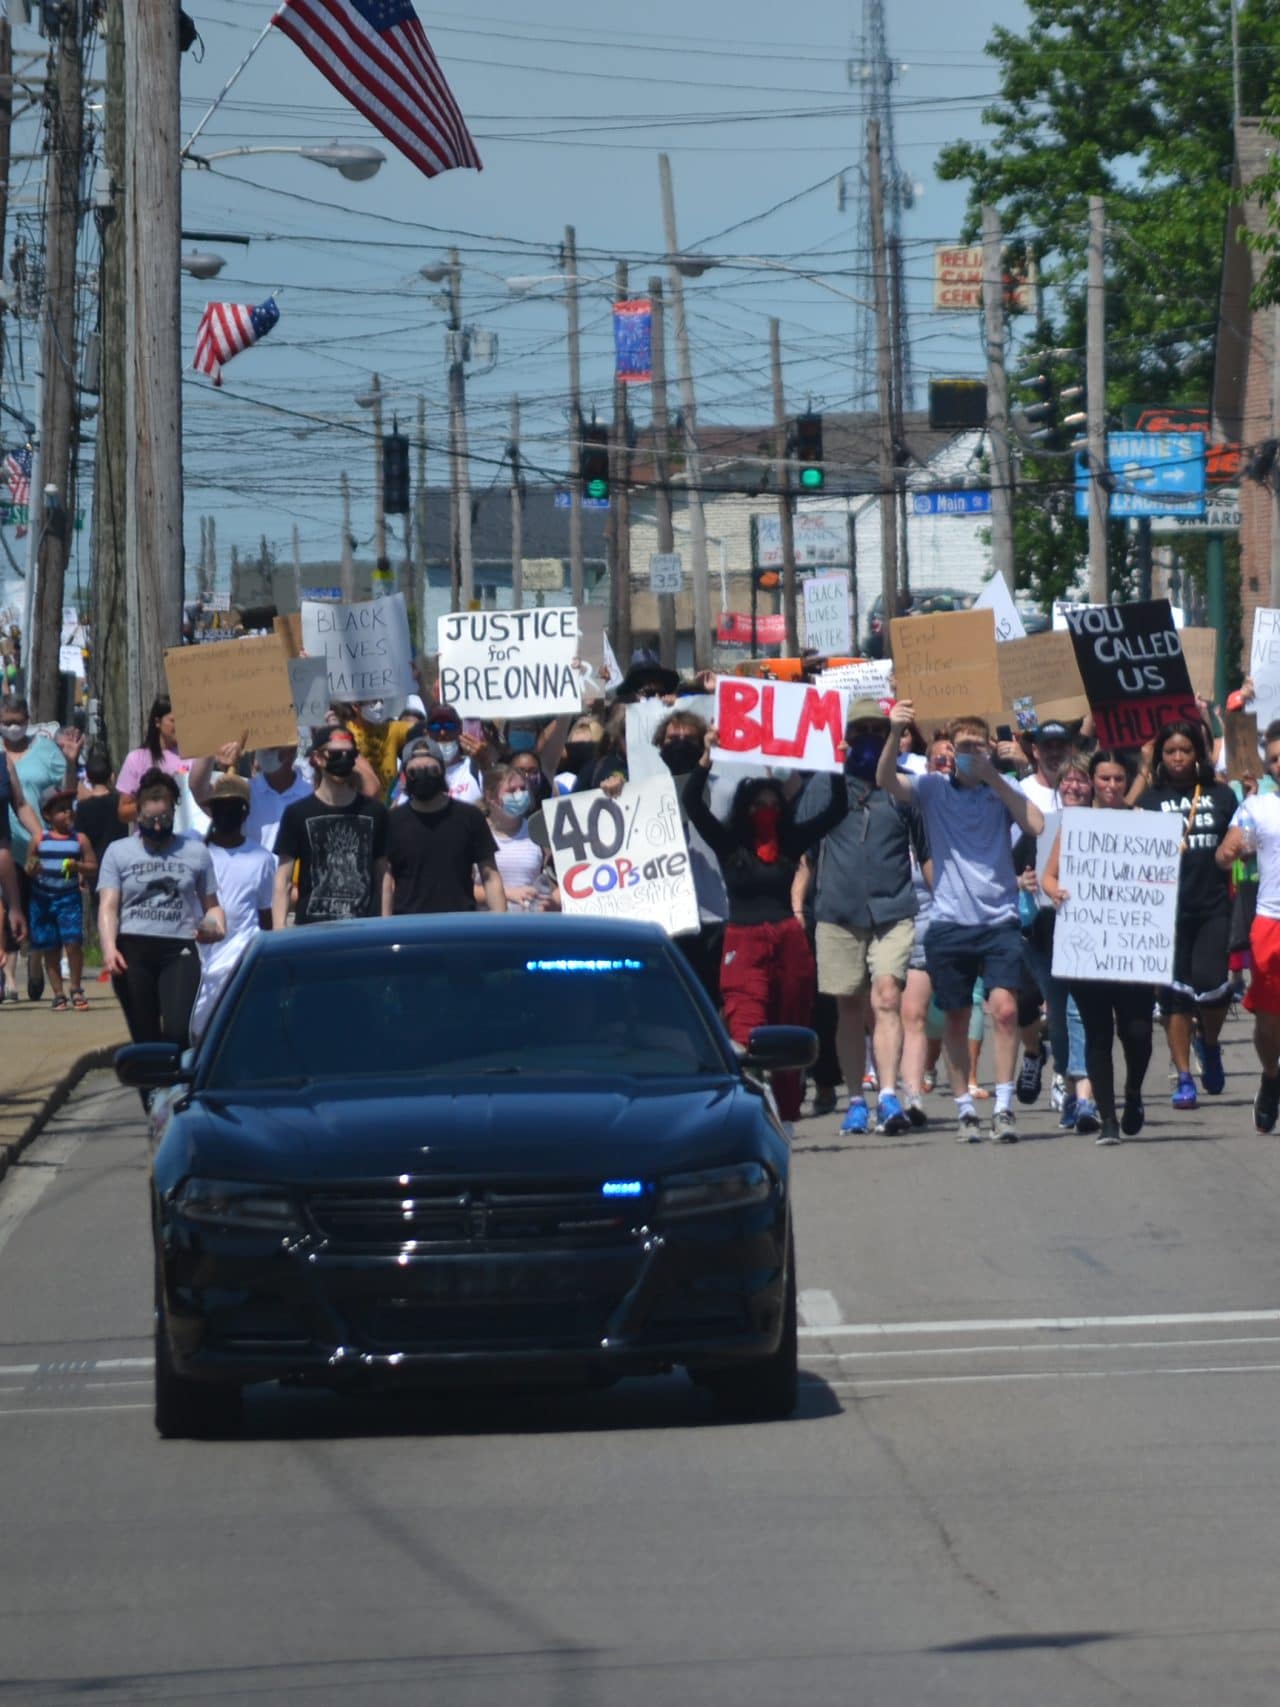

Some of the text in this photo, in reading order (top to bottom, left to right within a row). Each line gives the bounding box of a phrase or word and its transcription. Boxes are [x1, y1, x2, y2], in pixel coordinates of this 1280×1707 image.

[937, 493, 966, 512] Main
[317, 607, 388, 633] BLACK
[446, 610, 577, 642] JUSTICE
[1066, 607, 1124, 636] YOU
[324, 638, 388, 660] LIVES
[488, 645, 521, 662] for
[1094, 630, 1182, 662] CALLED
[440, 663, 578, 703] BREONNA
[1118, 665, 1166, 691] US
[719, 680, 846, 764] BLM
[1067, 831, 1179, 859] I UNDERSTAND
[131, 861, 186, 875] PEOPLE'S
[643, 852, 687, 881] are
[1063, 855, 1099, 879] THAT
[1103, 858, 1108, 879] I
[1137, 865, 1177, 882] NEVER
[130, 909, 181, 922] PROGRAM
[1063, 904, 1158, 928] HOWEVER
[1102, 932, 1171, 949] I STAND
[1093, 954, 1168, 974] WITH YOU
